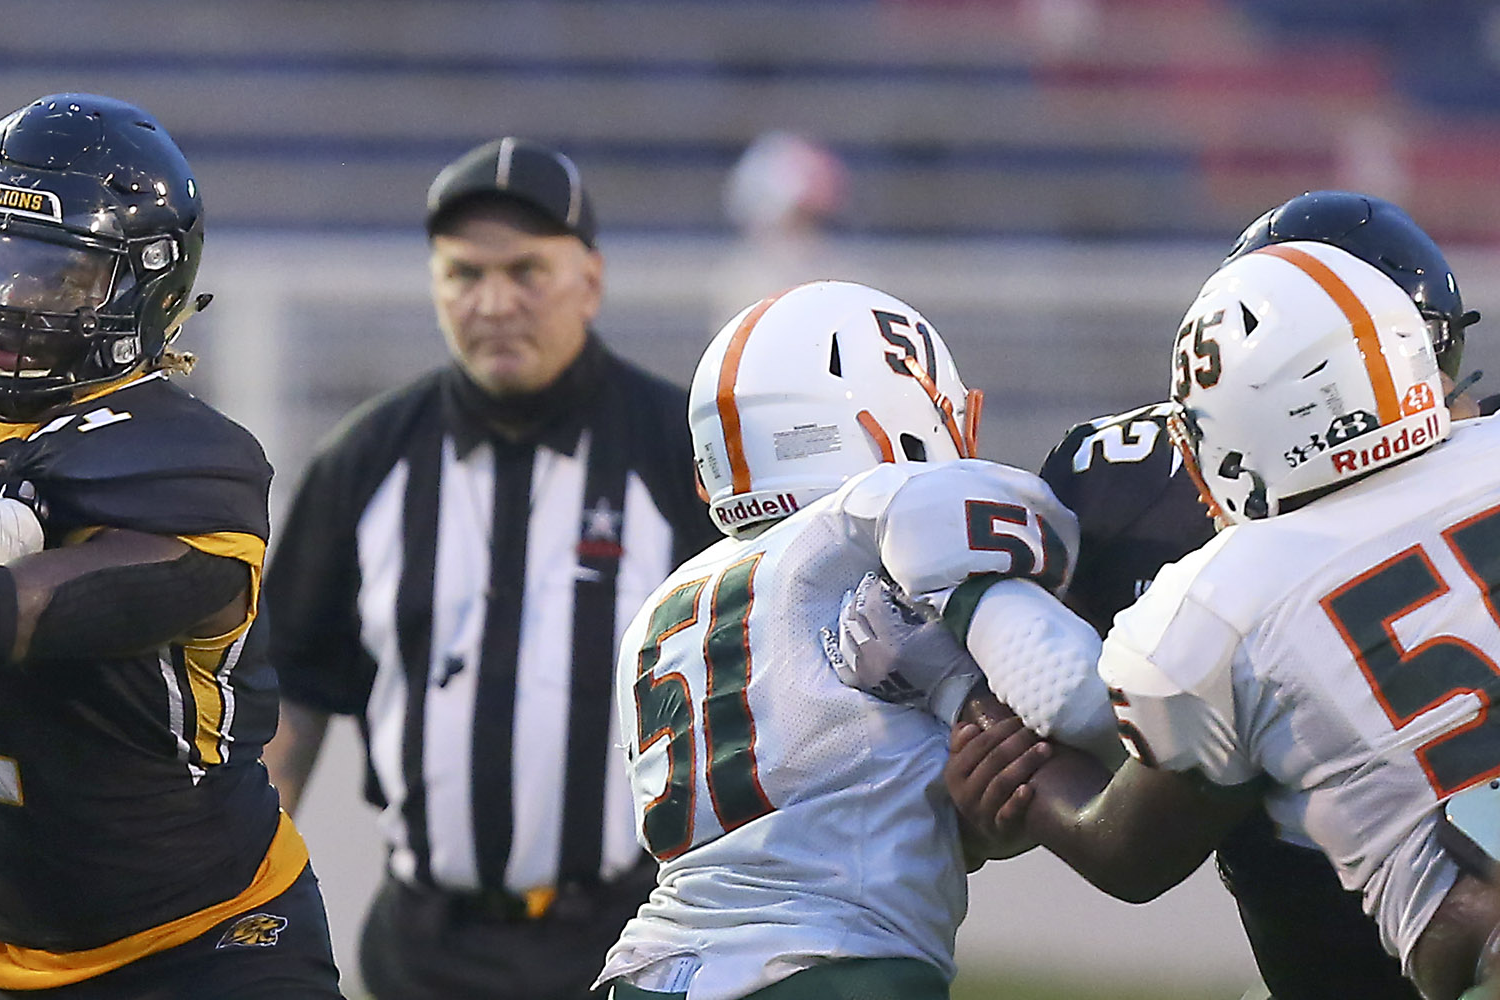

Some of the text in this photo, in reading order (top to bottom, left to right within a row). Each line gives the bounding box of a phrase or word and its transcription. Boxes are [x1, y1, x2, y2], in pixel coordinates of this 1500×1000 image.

[872, 309, 937, 380] 51
[1175, 308, 1226, 402] 55
[1330, 413, 1439, 475] Riddell
[715, 493, 800, 526] Riddell
[633, 551, 777, 861] 51
